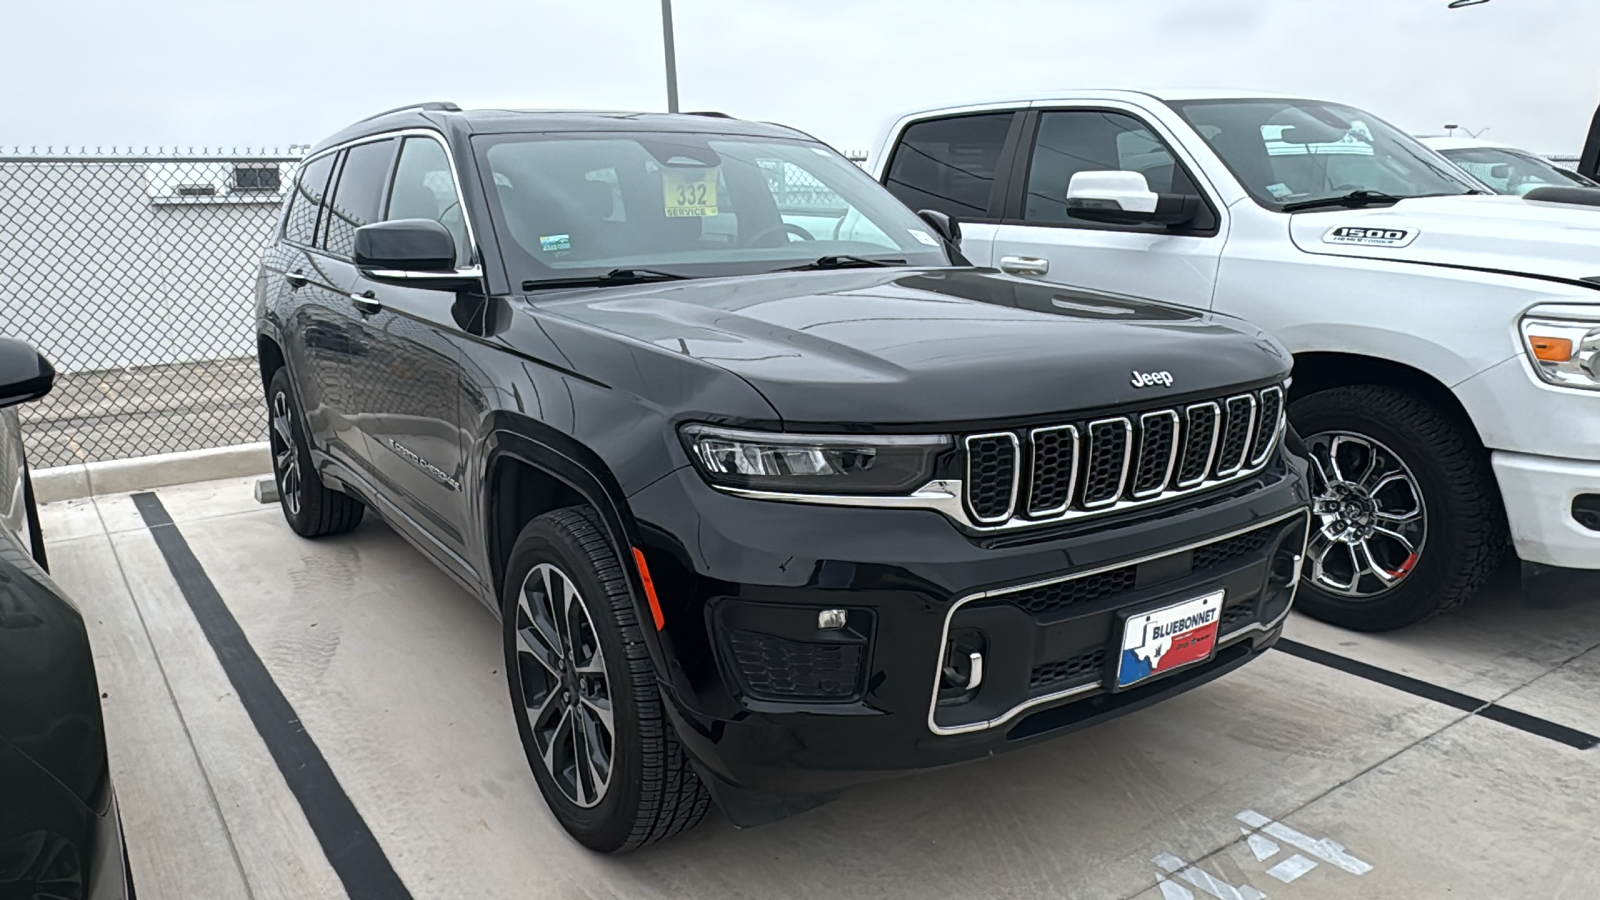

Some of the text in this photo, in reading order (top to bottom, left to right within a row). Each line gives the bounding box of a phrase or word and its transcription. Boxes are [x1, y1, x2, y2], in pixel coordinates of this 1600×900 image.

[676, 184, 707, 206] 332
[666, 208, 707, 216] SERVICE
[1340, 228, 1404, 240] 1500
[1131, 370, 1174, 388] Jeep
[1152, 607, 1217, 641] BLUEBONNET
